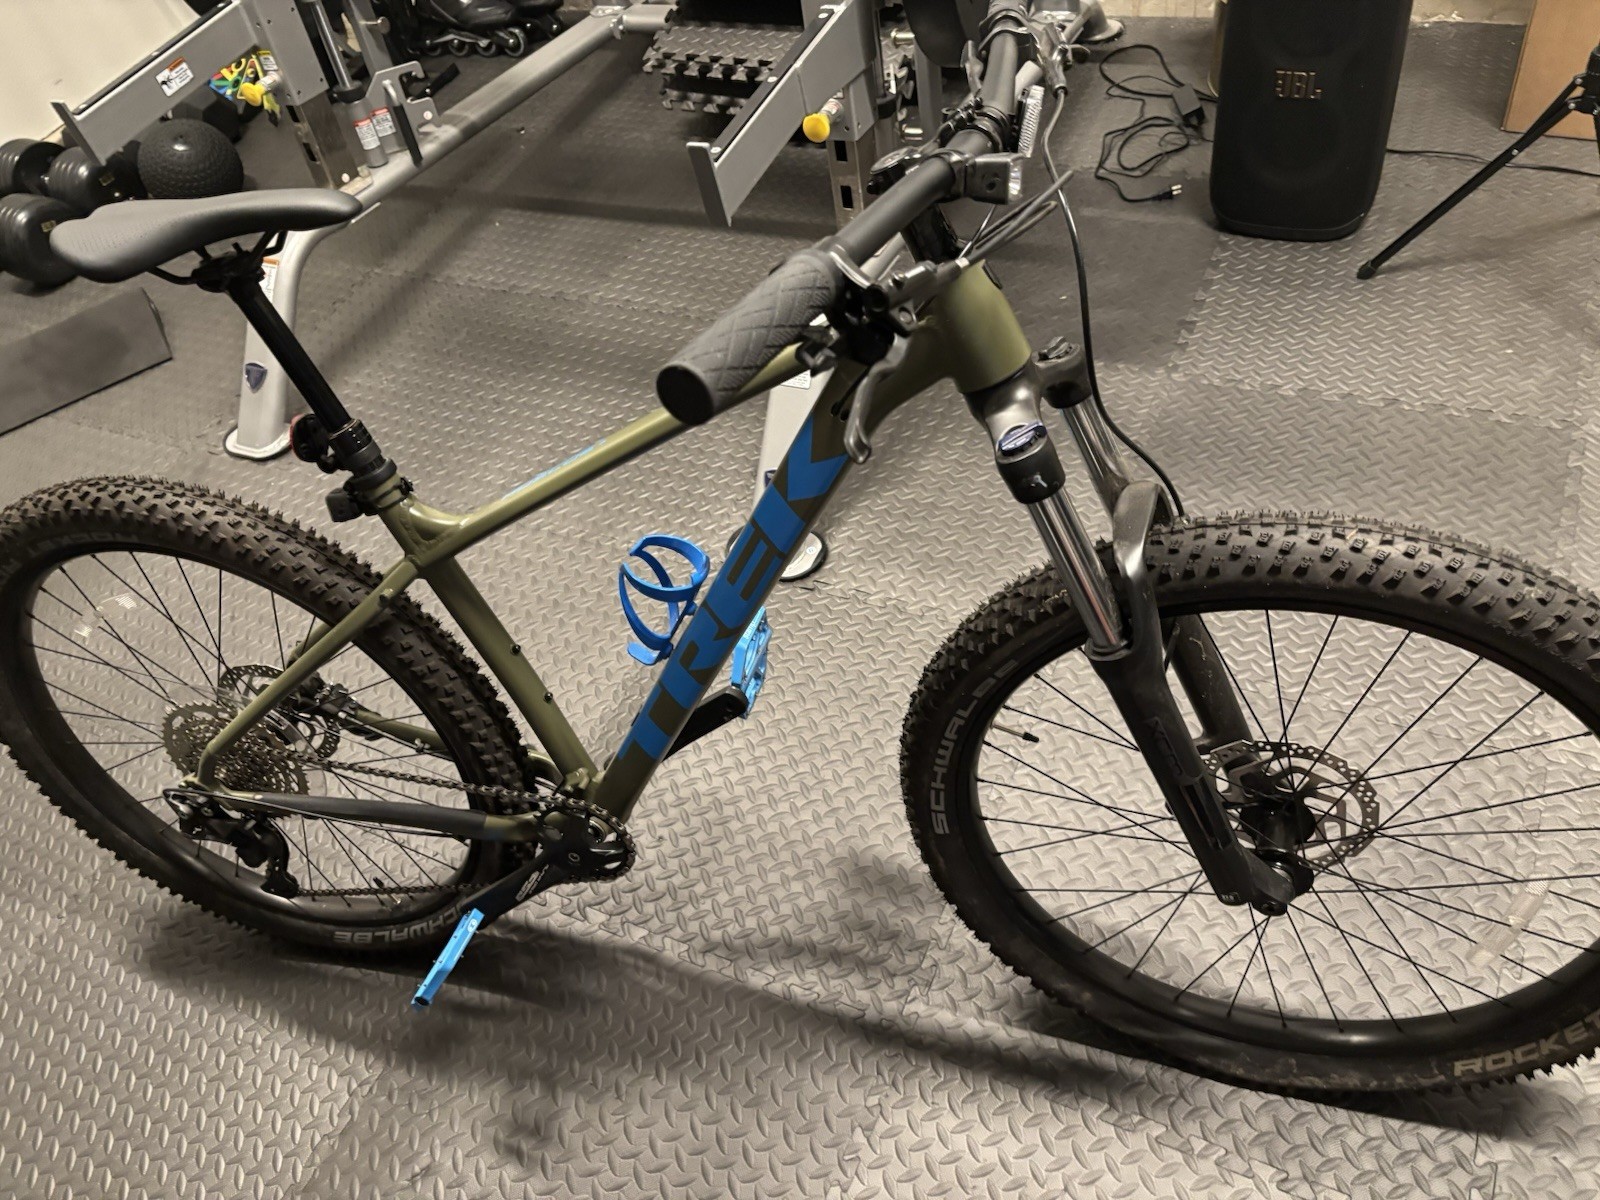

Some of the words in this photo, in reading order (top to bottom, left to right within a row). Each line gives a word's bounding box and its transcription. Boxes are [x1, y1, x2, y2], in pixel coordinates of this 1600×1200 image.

[1275, 70, 1322, 99] JBL
[618, 411, 848, 761] TREK
[930, 659, 1019, 836] SCHWALBE
[334, 905, 459, 944] CHWALBE
